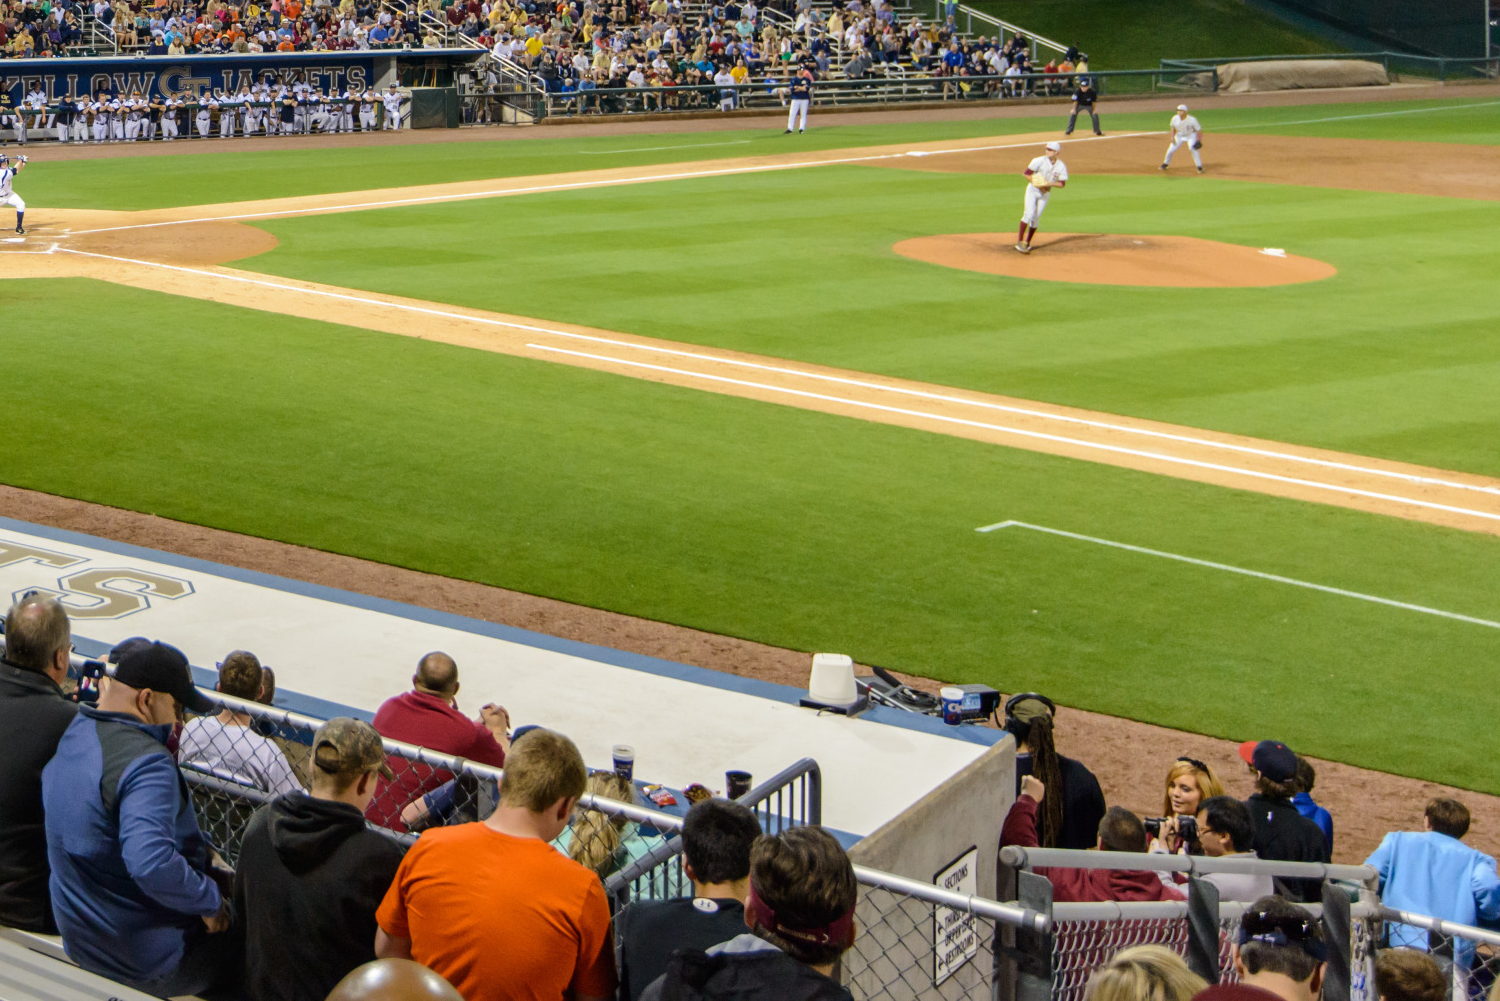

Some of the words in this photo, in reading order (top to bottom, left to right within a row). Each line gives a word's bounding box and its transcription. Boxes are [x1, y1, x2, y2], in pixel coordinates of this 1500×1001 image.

[159, 66, 212, 100] GT
[944, 864, 968, 889] SECTIONS
[945, 933, 974, 966] RESTROOMS
